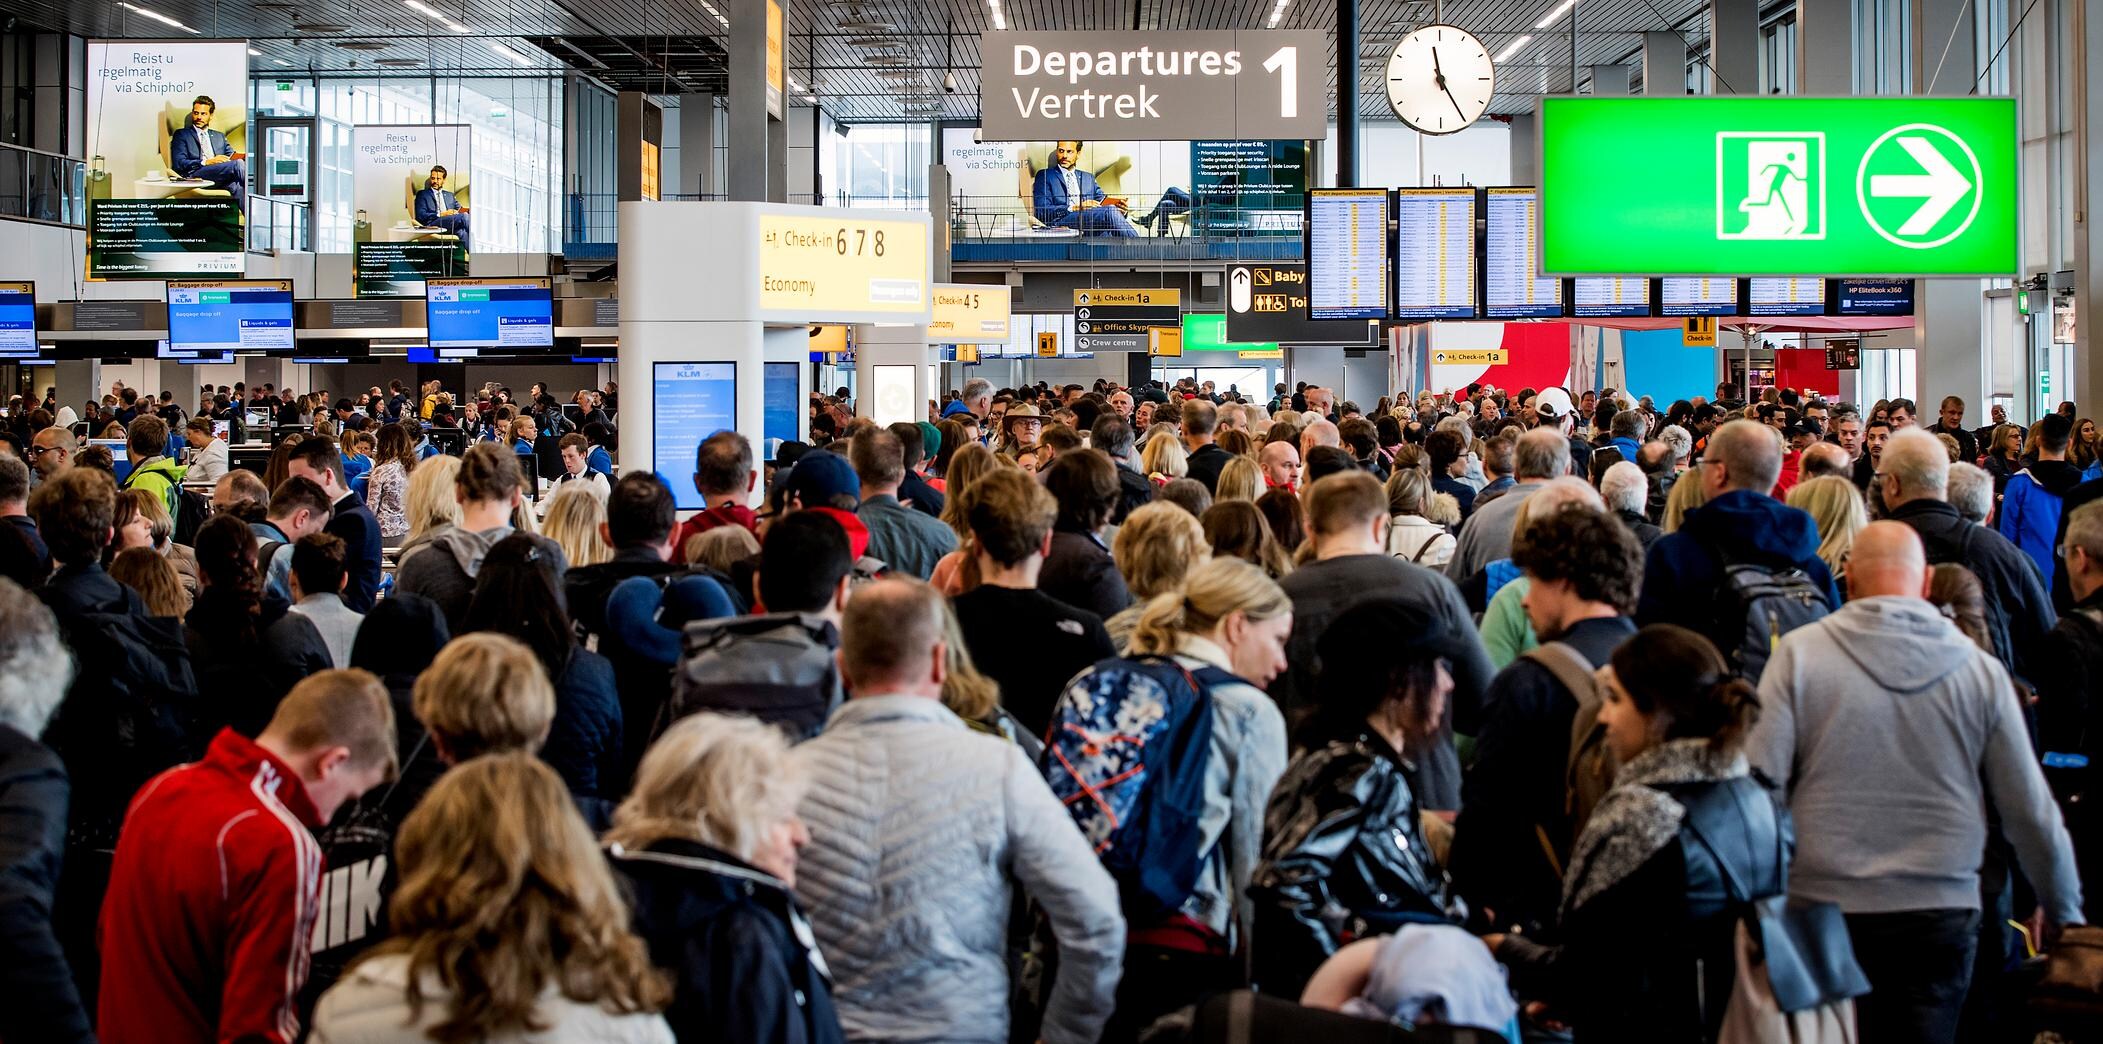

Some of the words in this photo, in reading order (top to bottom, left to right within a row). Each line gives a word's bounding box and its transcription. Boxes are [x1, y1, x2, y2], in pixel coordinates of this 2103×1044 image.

[133, 52, 163, 64] Reist
[166, 54, 174, 64] u
[98, 66, 162, 80] regelmatig
[1013, 44, 1242, 84] Departures
[1262, 46, 1298, 118] 1
[115, 82, 132, 93] via
[135, 81, 194, 95] Schiphol?
[1011, 84, 1161, 119] Vertrek
[386, 133, 409, 142] Reist
[360, 144, 408, 154] regelmatig
[952, 147, 1004, 159] regelmatig
[373, 156, 386, 164] via
[388, 155, 432, 165] Schiphol?
[965, 160, 980, 169] via
[982, 159, 1029, 171] Schiphol?
[784, 230, 833, 248] Check-in
[836, 228, 847, 255] 6
[856, 229, 866, 256] 7
[874, 230, 885, 257] 8
[541, 279, 546, 287] 1
[1274, 271, 1306, 284] Baby
[22, 284, 28, 292] 3
[281, 281, 287, 290] 2
[764, 275, 816, 296] Economy
[938, 295, 962, 305] Check-in
[964, 294, 970, 308] 4
[973, 294, 979, 309] 5
[1136, 293, 1150, 304] 1a
[929, 320, 955, 331] conomy
[1686, 334, 1713, 342] Check-in
[1486, 352, 1499, 361] 1a
[677, 370, 701, 378] KLM
